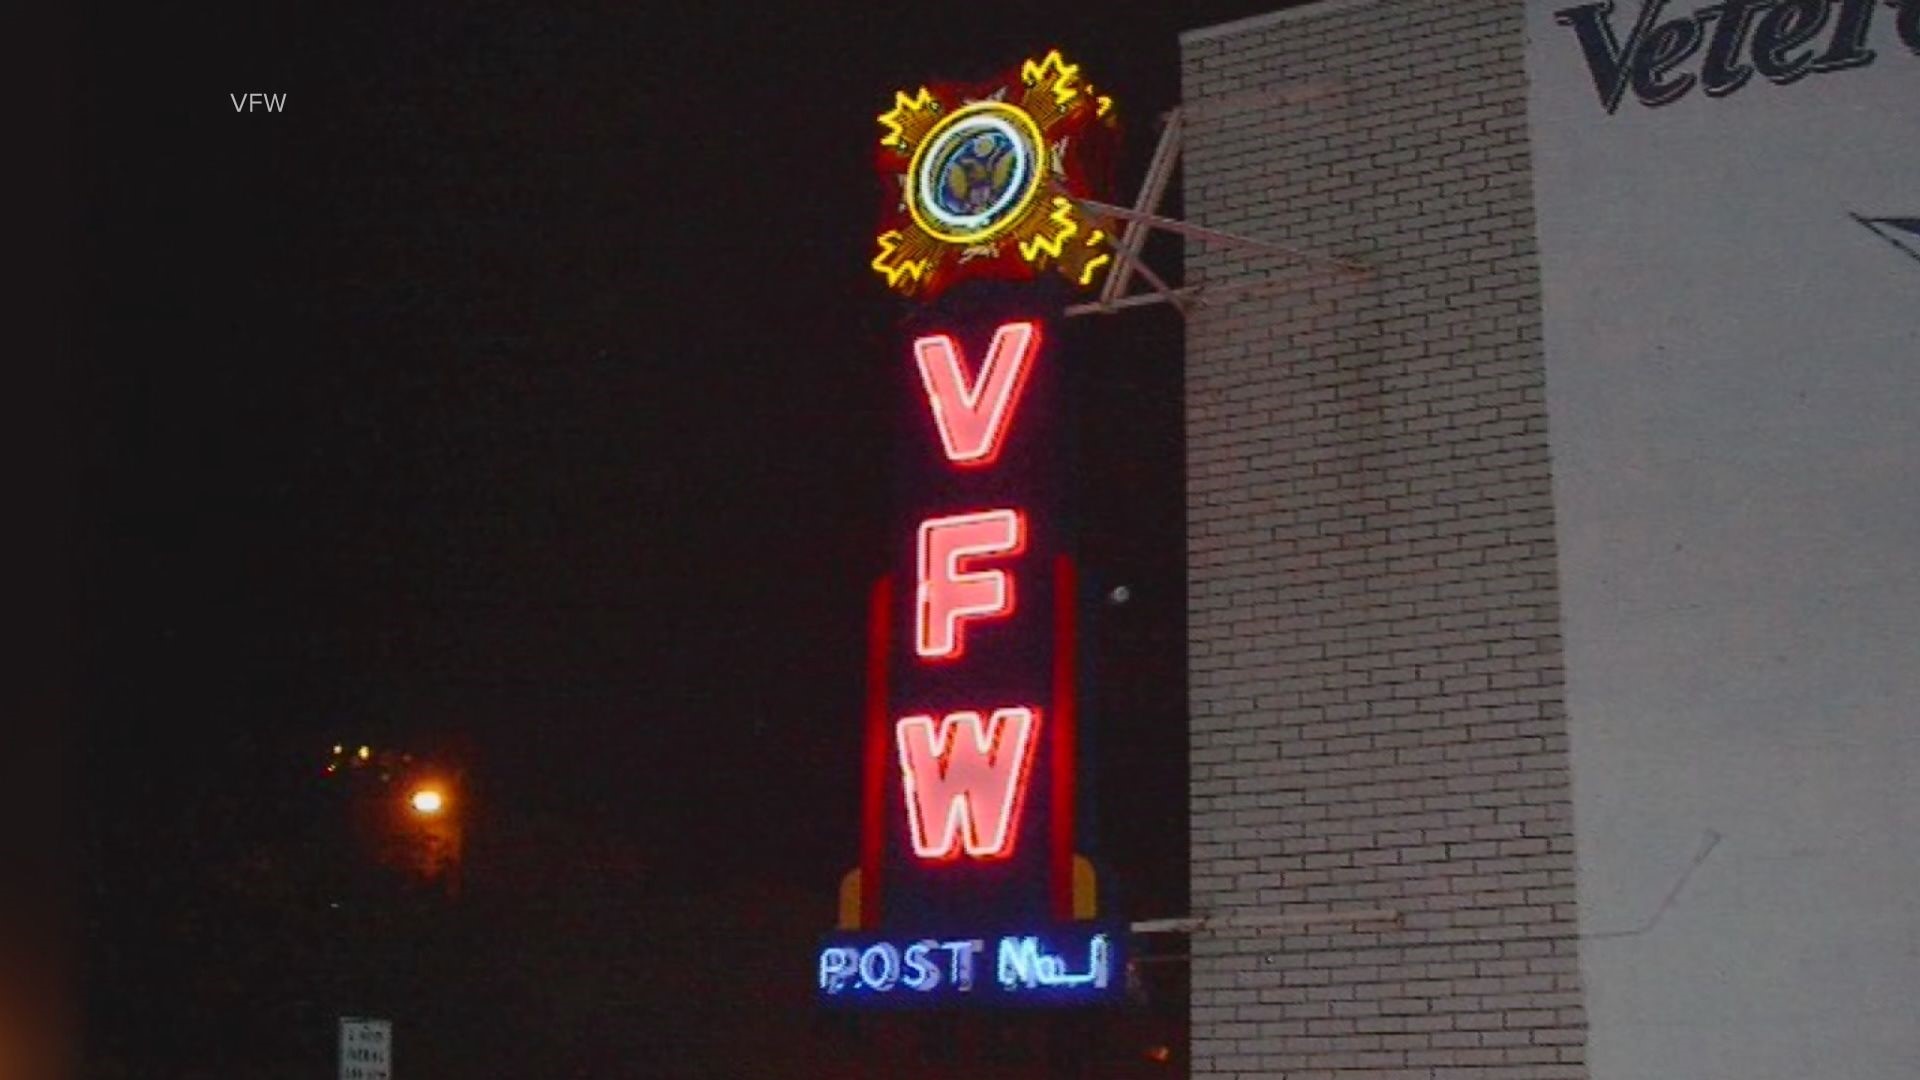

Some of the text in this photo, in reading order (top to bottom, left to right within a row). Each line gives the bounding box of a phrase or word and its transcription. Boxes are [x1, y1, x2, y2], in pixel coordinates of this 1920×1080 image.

[1553, 0, 1920, 115] Veter
[897, 322, 1042, 862] VFW
[819, 939, 984, 994] POST
